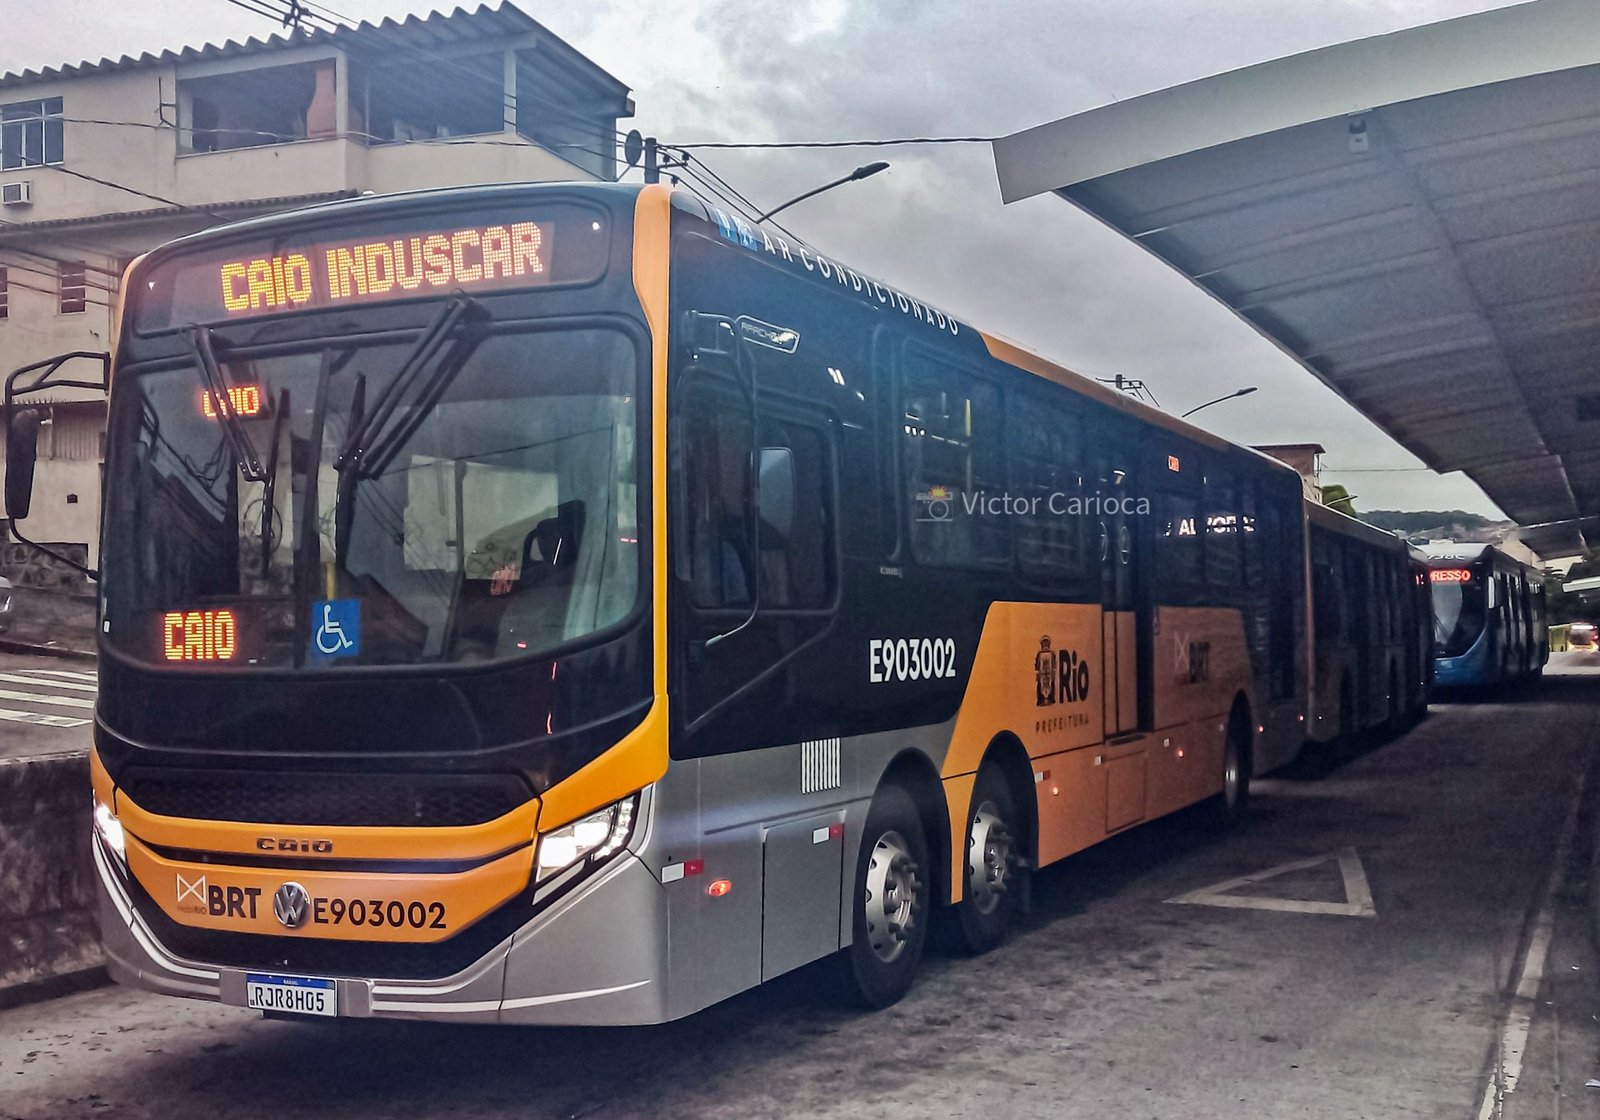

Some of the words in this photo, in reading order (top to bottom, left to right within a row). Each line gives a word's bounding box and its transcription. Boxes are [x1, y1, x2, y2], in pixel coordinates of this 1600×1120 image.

[220, 254, 312, 312] CAIO
[326, 221, 543, 299] INDUSCAR
[762, 231, 793, 263] AR
[799, 247, 959, 336] CONDICIONADO
[164, 611, 235, 660] CAIO
[869, 637, 956, 683] E903002
[1059, 649, 1089, 704] Rio
[1036, 713, 1089, 734] PREFEITURA
[208, 885, 262, 919] BRT
[313, 897, 447, 929] E903002
[254, 986, 325, 1013] RJR8H05
